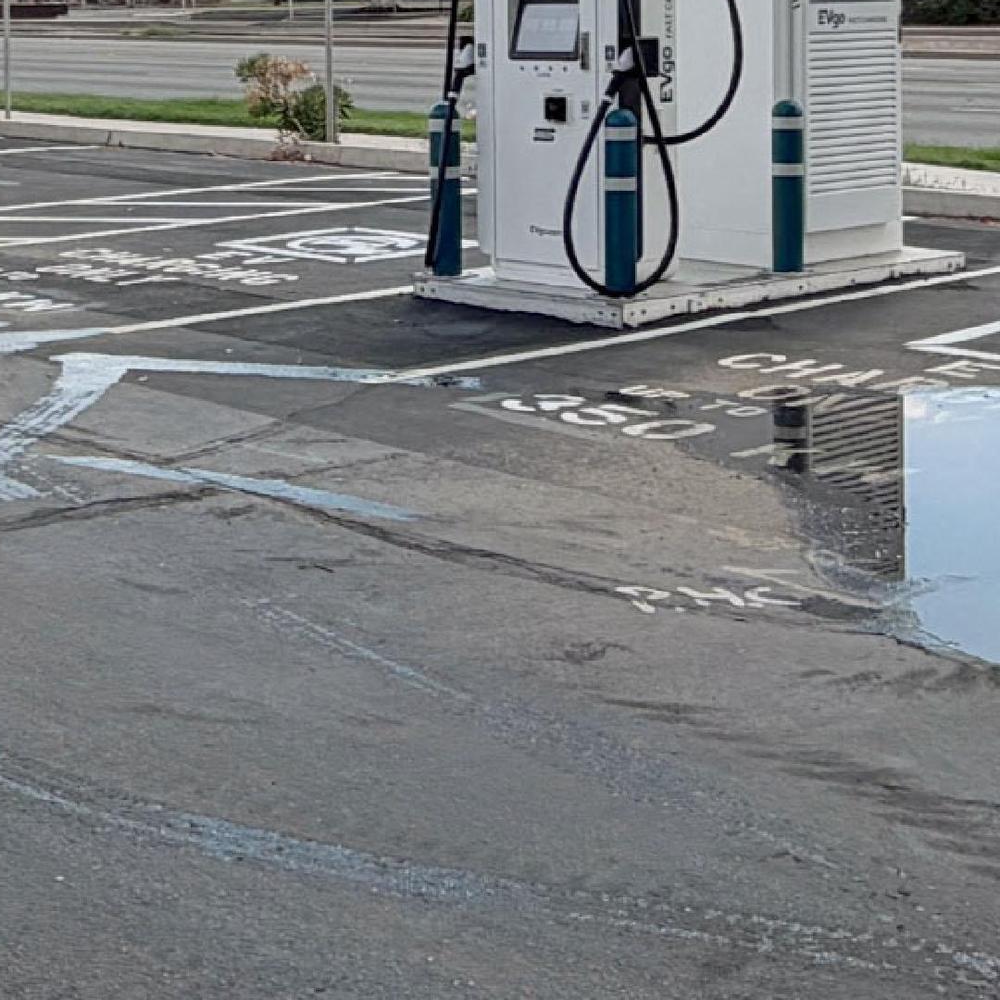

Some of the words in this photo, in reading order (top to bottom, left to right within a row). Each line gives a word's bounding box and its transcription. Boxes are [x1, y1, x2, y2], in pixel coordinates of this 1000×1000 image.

[818, 9, 846, 28] EVgo
[660, 46, 675, 104] EVgo
[501, 394, 716, 440] 350
[700, 399, 768, 418] TO
